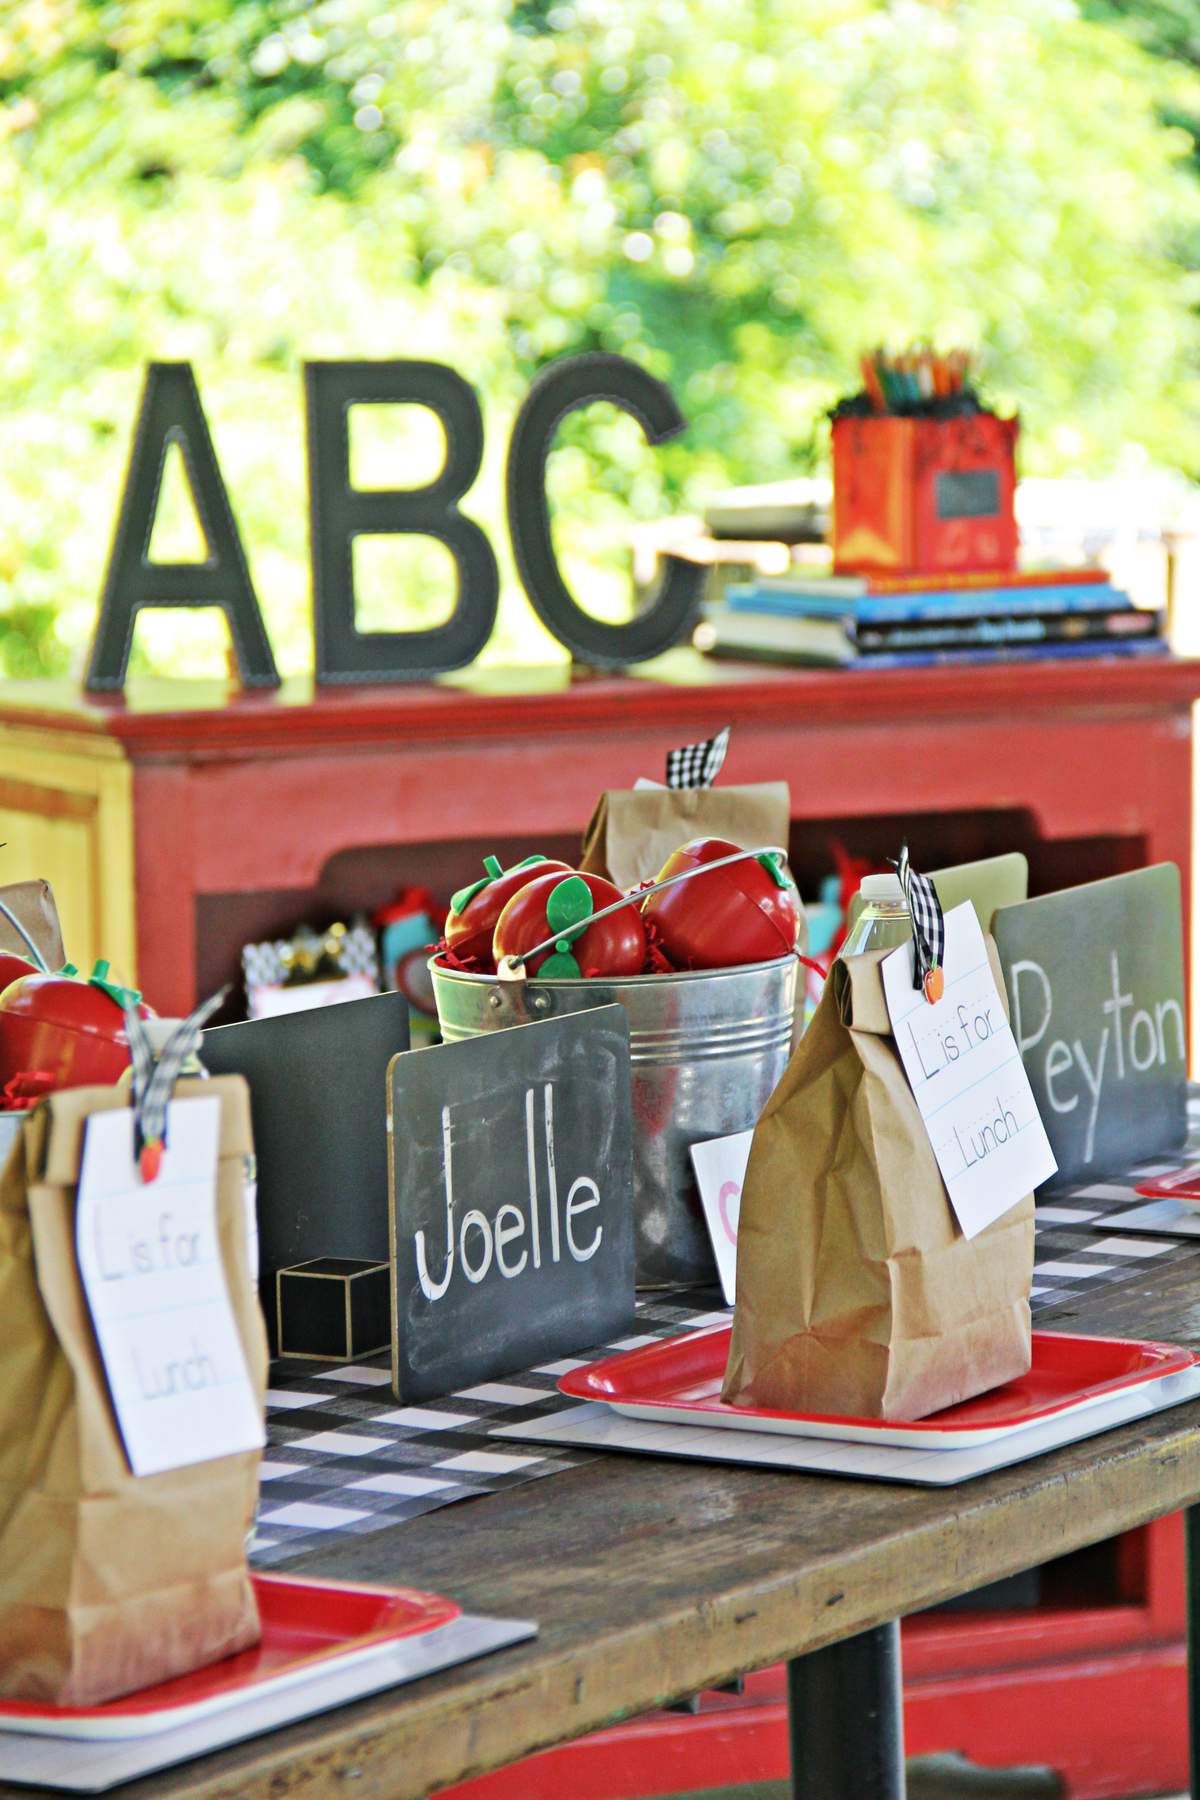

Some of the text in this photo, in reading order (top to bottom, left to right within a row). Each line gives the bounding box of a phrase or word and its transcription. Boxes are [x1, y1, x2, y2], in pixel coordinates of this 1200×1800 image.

[84, 351, 709, 690] ABC
[907, 1004, 995, 1080] L is for
[1011, 950, 1185, 1163] Peyton
[952, 1097, 1019, 1169] Lunch
[415, 1082, 602, 1300] Joelle
[128, 1231, 154, 1274] is
[157, 1211, 202, 1270] for
[130, 1336, 220, 1401] Lunch
